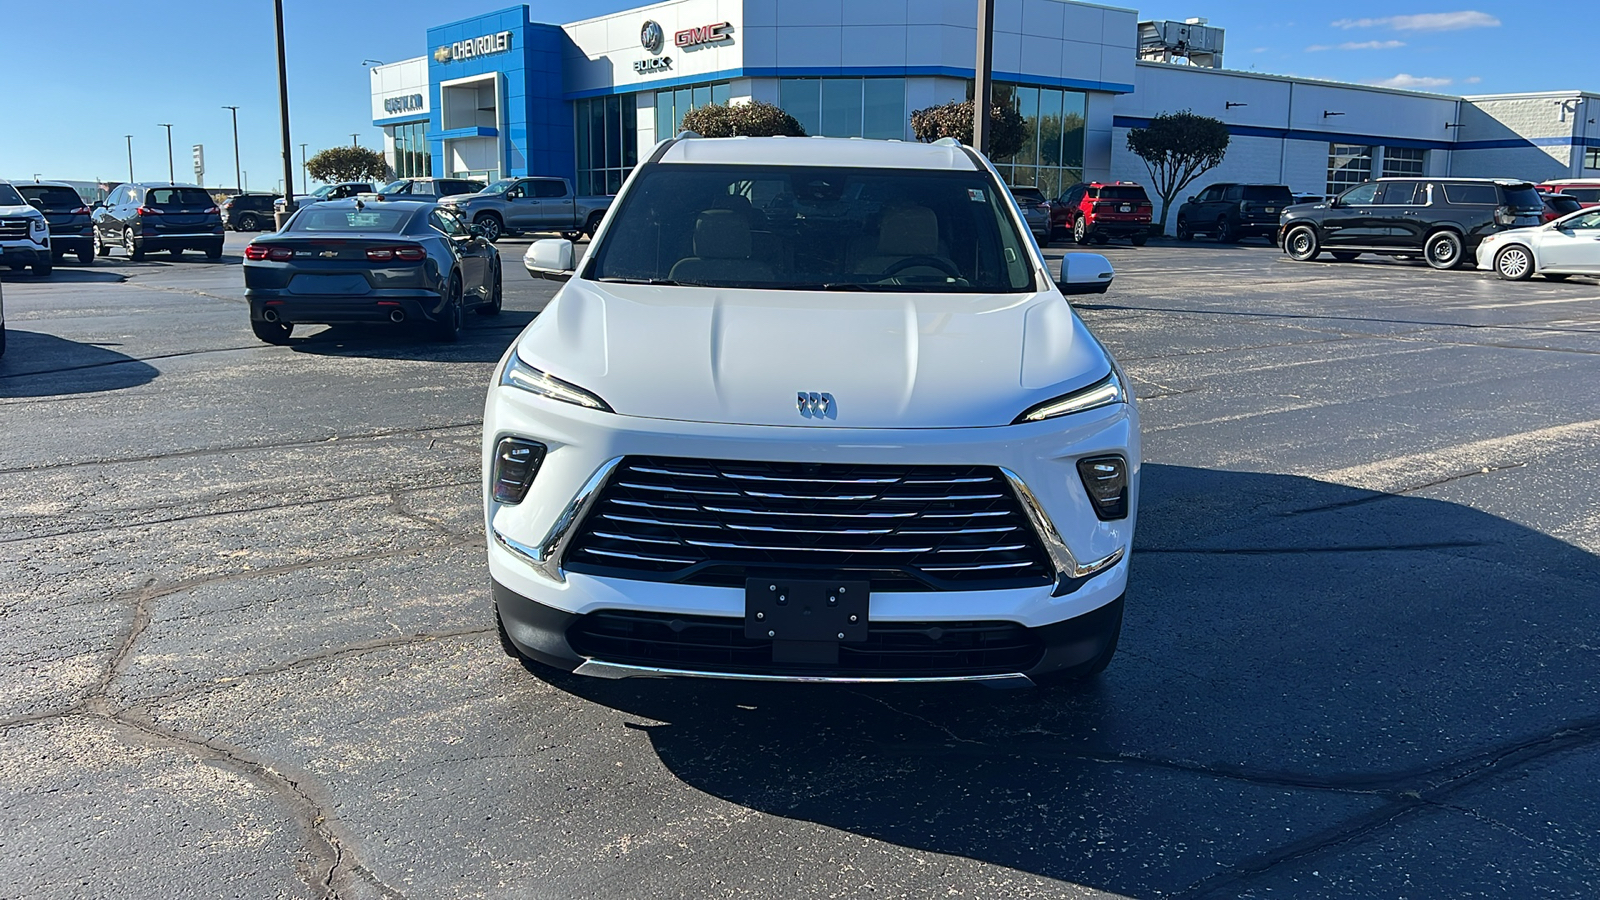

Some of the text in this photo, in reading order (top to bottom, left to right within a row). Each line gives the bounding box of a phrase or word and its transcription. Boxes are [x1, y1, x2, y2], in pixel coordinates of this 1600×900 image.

[452, 31, 509, 60] CHEVROLET
[675, 22, 727, 47] GMC
[633, 57, 667, 71] BUICK
